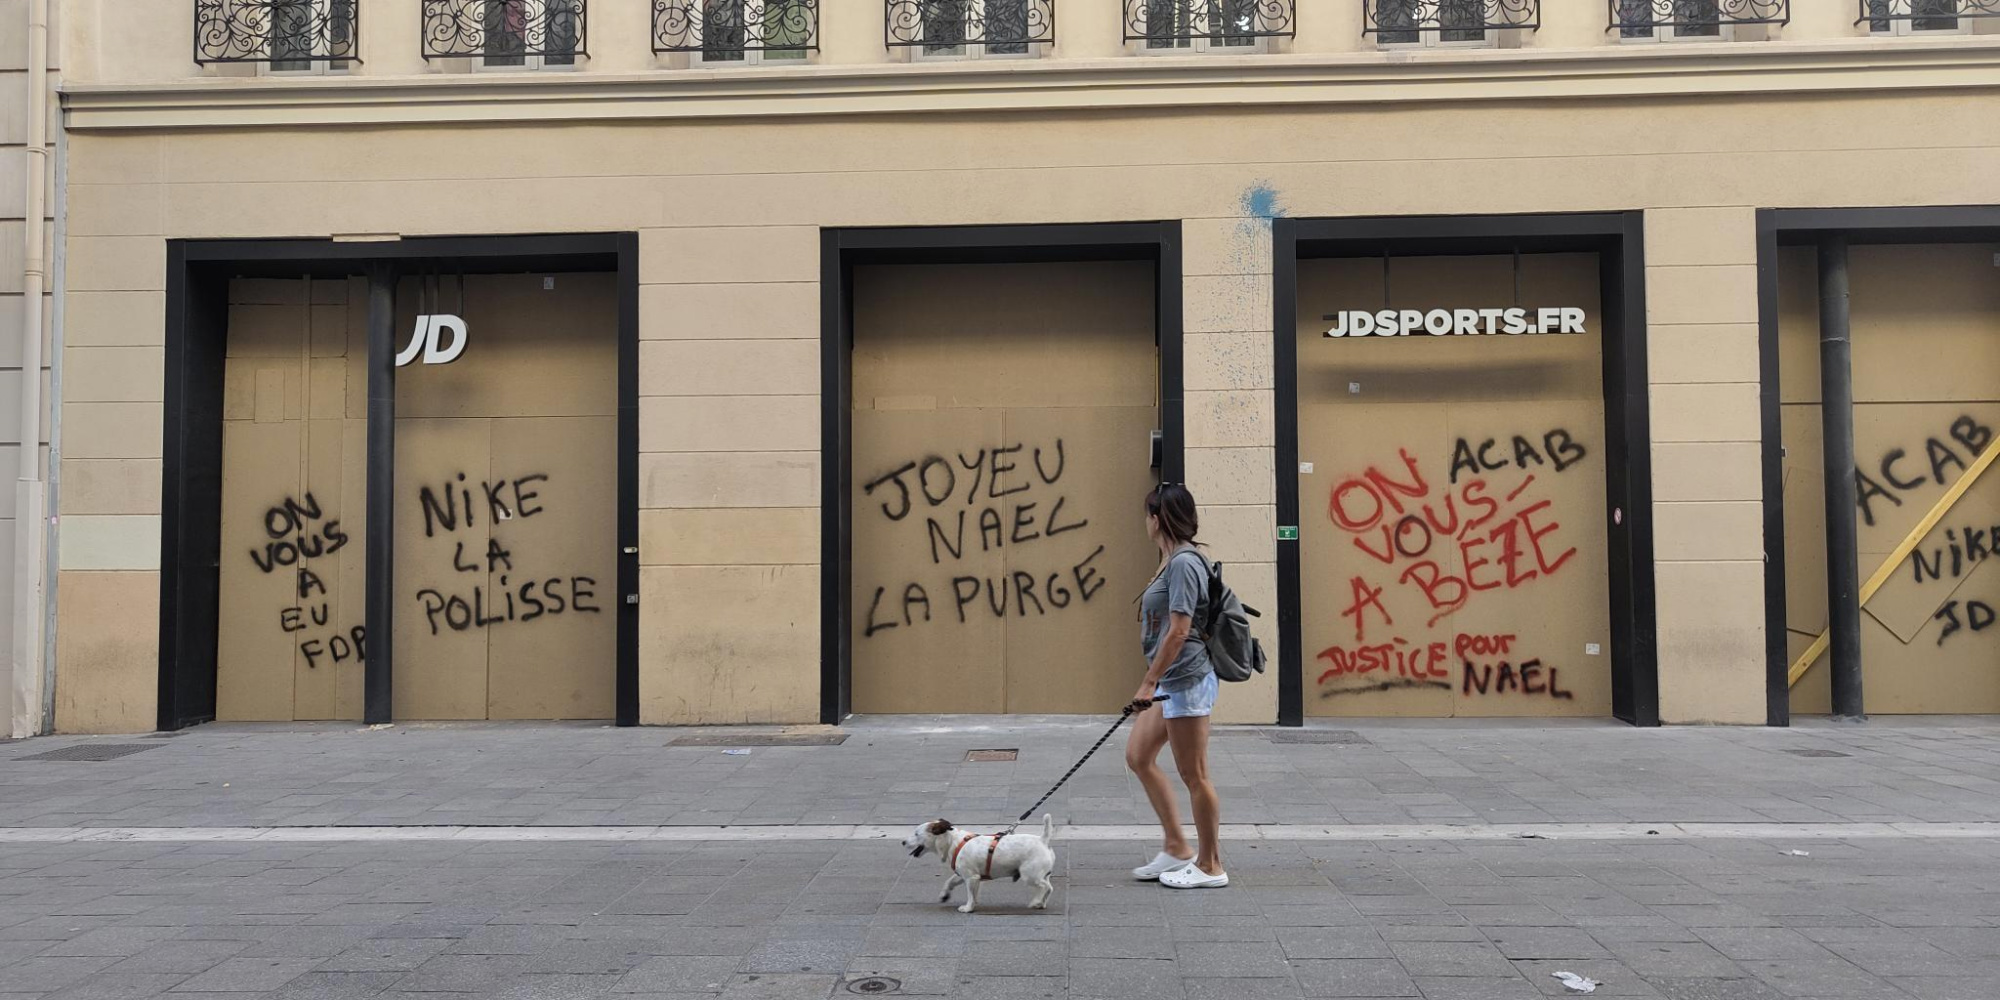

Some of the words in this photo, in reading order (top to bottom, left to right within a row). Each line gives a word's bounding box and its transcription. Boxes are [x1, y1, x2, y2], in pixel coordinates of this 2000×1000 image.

[396, 314, 468, 367] JD
[1326, 306, 1587, 339] JDSPORTS.FR
[863, 438, 1064, 521] JOYEU
[1449, 429, 1586, 484] ACAB
[1854, 415, 1993, 527] ACAB
[264, 492, 322, 540] ON
[1330, 448, 1428, 533] ON
[249, 521, 349, 572] VOUS
[926, 496, 1088, 564] NAEL
[1353, 479, 1498, 564] VOUS
[454, 538, 511, 572] LA
[299, 568, 326, 599] A
[864, 582, 931, 638] LA
[952, 545, 1106, 624] PURGE
[1341, 576, 1393, 642] A
[281, 604, 328, 633] EU
[1934, 600, 1996, 647] JD
[300, 624, 366, 670] FDP
[1462, 658, 1573, 699] NAEL
